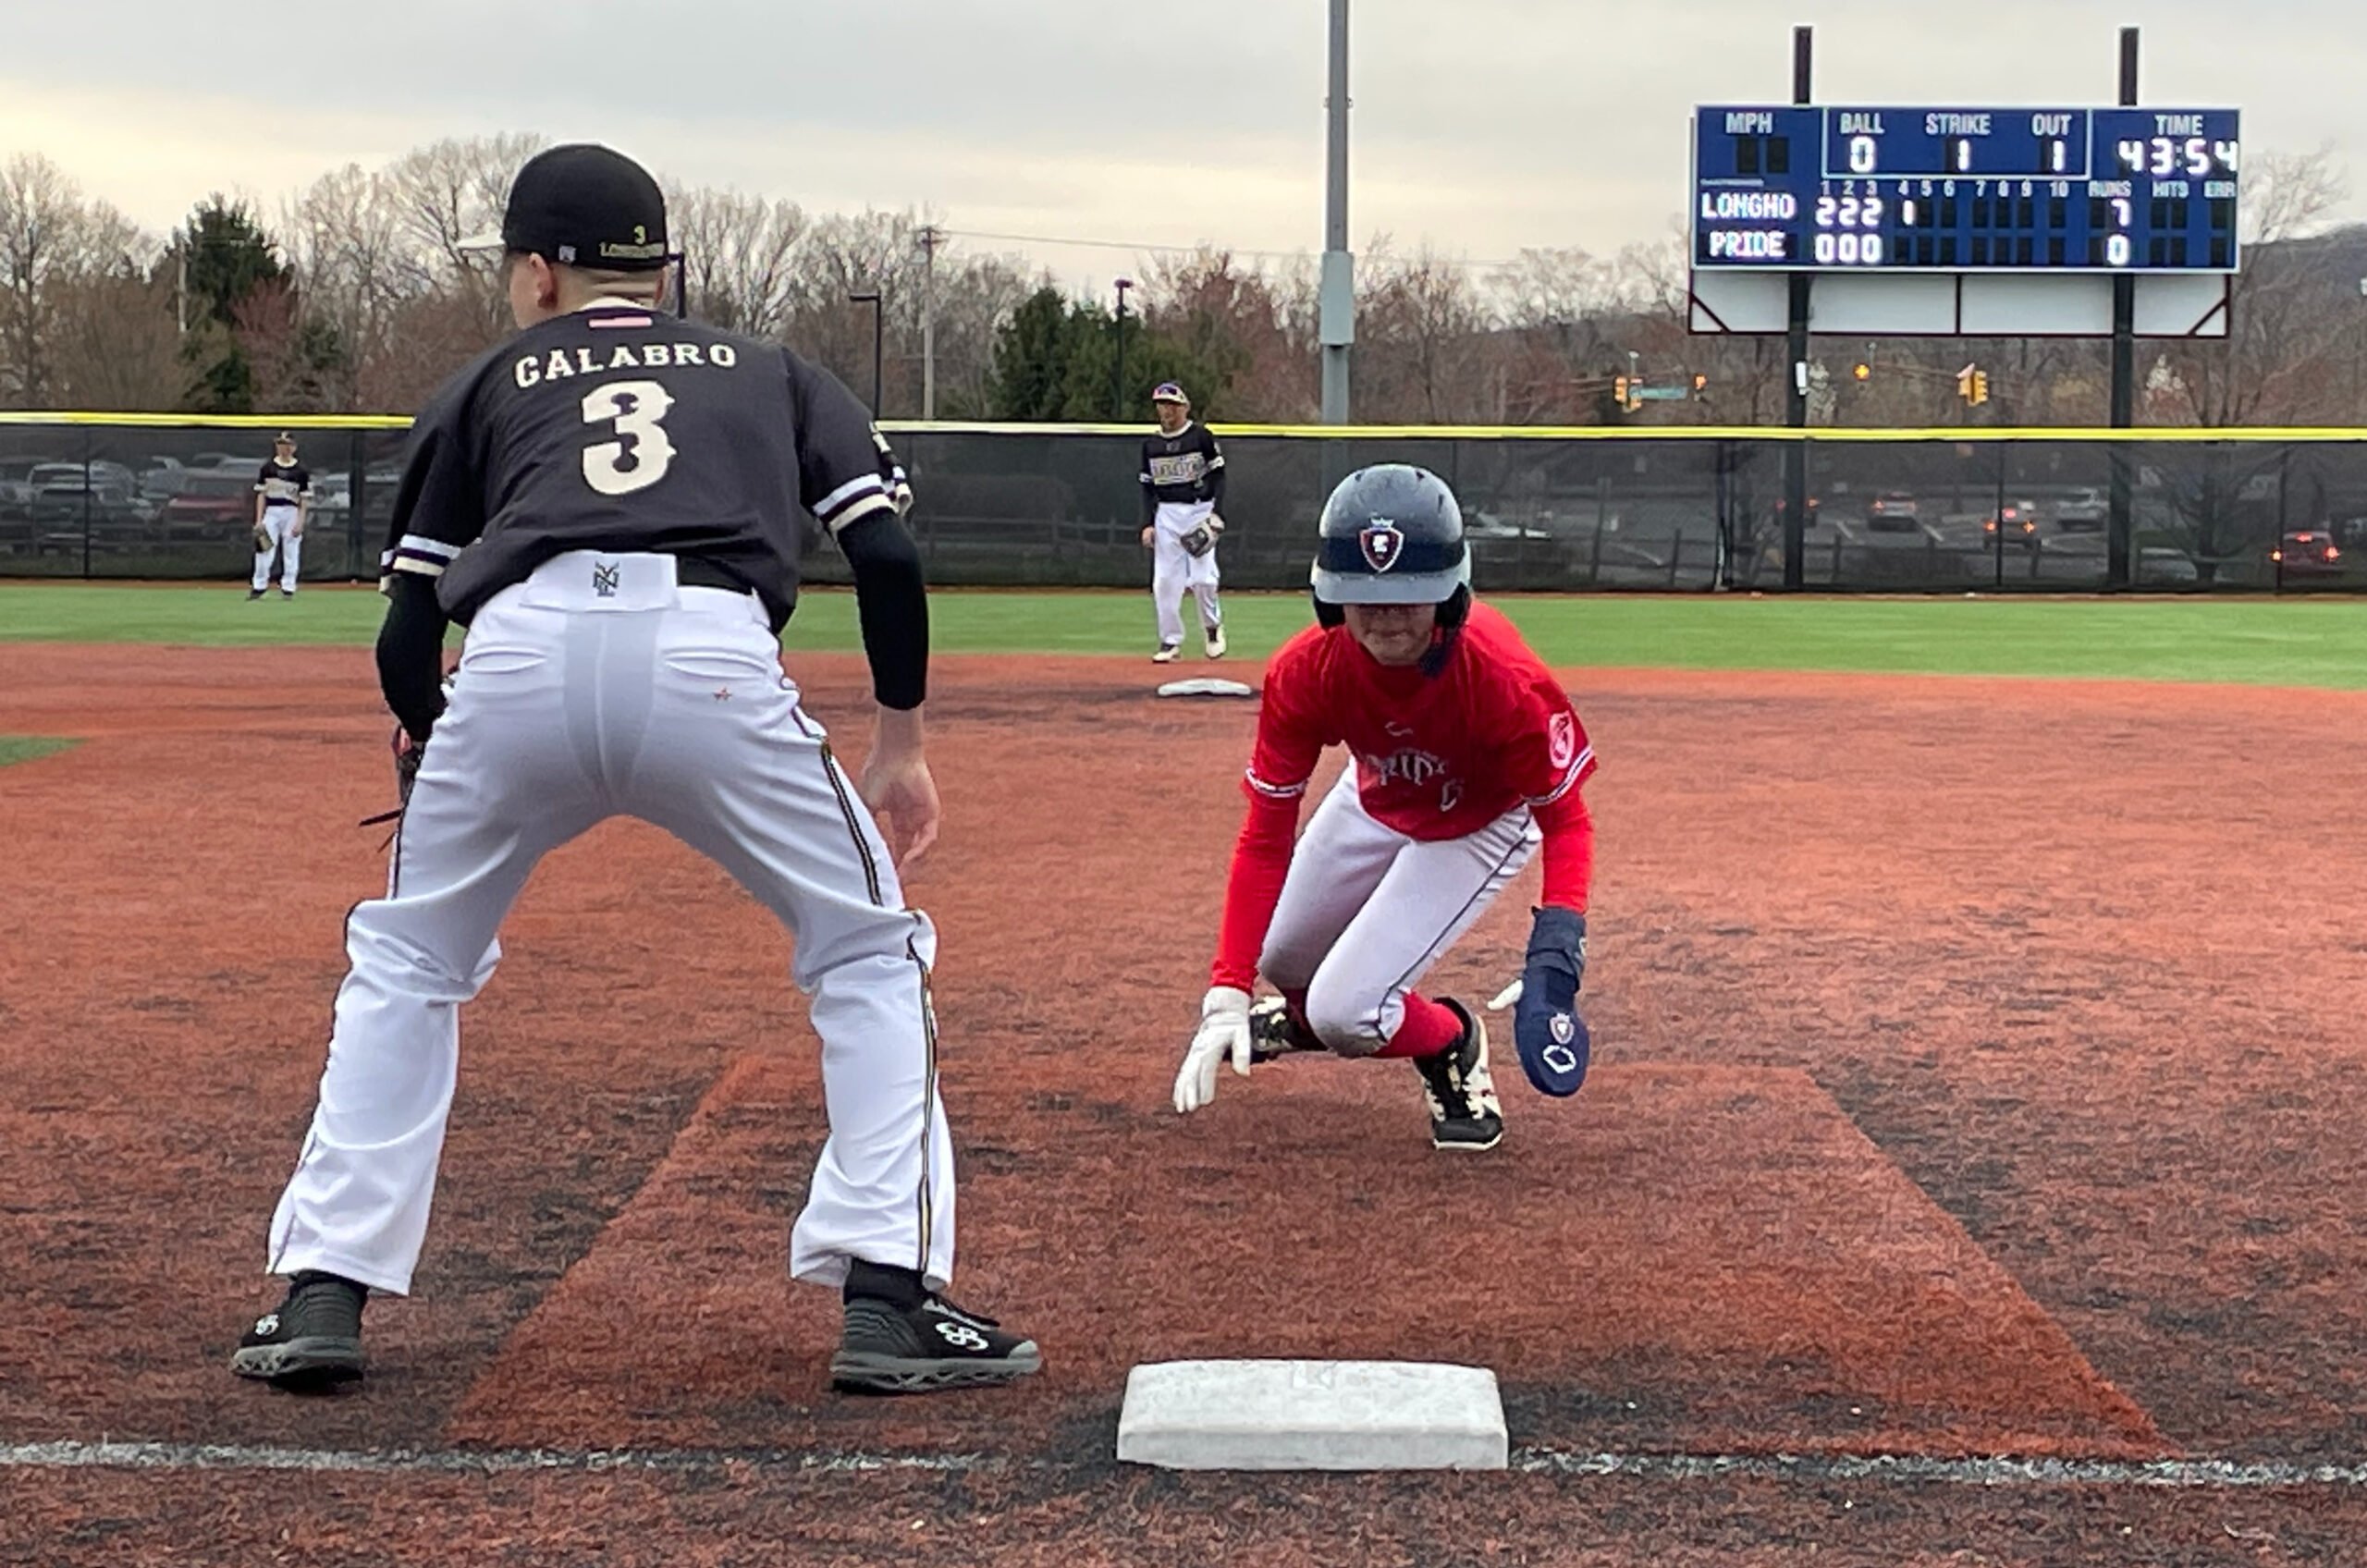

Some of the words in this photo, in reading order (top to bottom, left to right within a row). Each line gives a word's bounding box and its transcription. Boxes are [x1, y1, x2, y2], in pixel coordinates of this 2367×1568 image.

[1725, 112, 1773, 134] MPH
[1839, 112, 1885, 135] BALL
[1925, 113, 1992, 135] STRIKE
[2031, 113, 2072, 136] OUT
[2154, 114, 2204, 136] TIME
[1849, 135, 1876, 174] 0
[1956, 139, 1971, 172] 1
[2052, 140, 2066, 172] 1
[2117, 138, 2239, 176] 43:54
[1820, 179, 1831, 196] 1
[1842, 179, 1855, 196] 2
[1866, 179, 1879, 196] 3
[1897, 179, 1910, 196] 4
[1920, 179, 1933, 197] 5
[1943, 179, 1956, 197] 6
[1975, 179, 1987, 198] 7
[1997, 180, 2010, 198] 8
[2020, 180, 2033, 198] 9
[2049, 180, 2069, 198] 10
[2152, 180, 2189, 198] HITS
[1700, 191, 1797, 220] LONGHO
[2110, 197, 2131, 227] 7
[633, 225, 645, 245] 3
[1709, 229, 1787, 258] PRIDE
[2106, 233, 2130, 266] 0
[514, 342, 737, 389] GALABRO
[583, 379, 677, 496] 3
